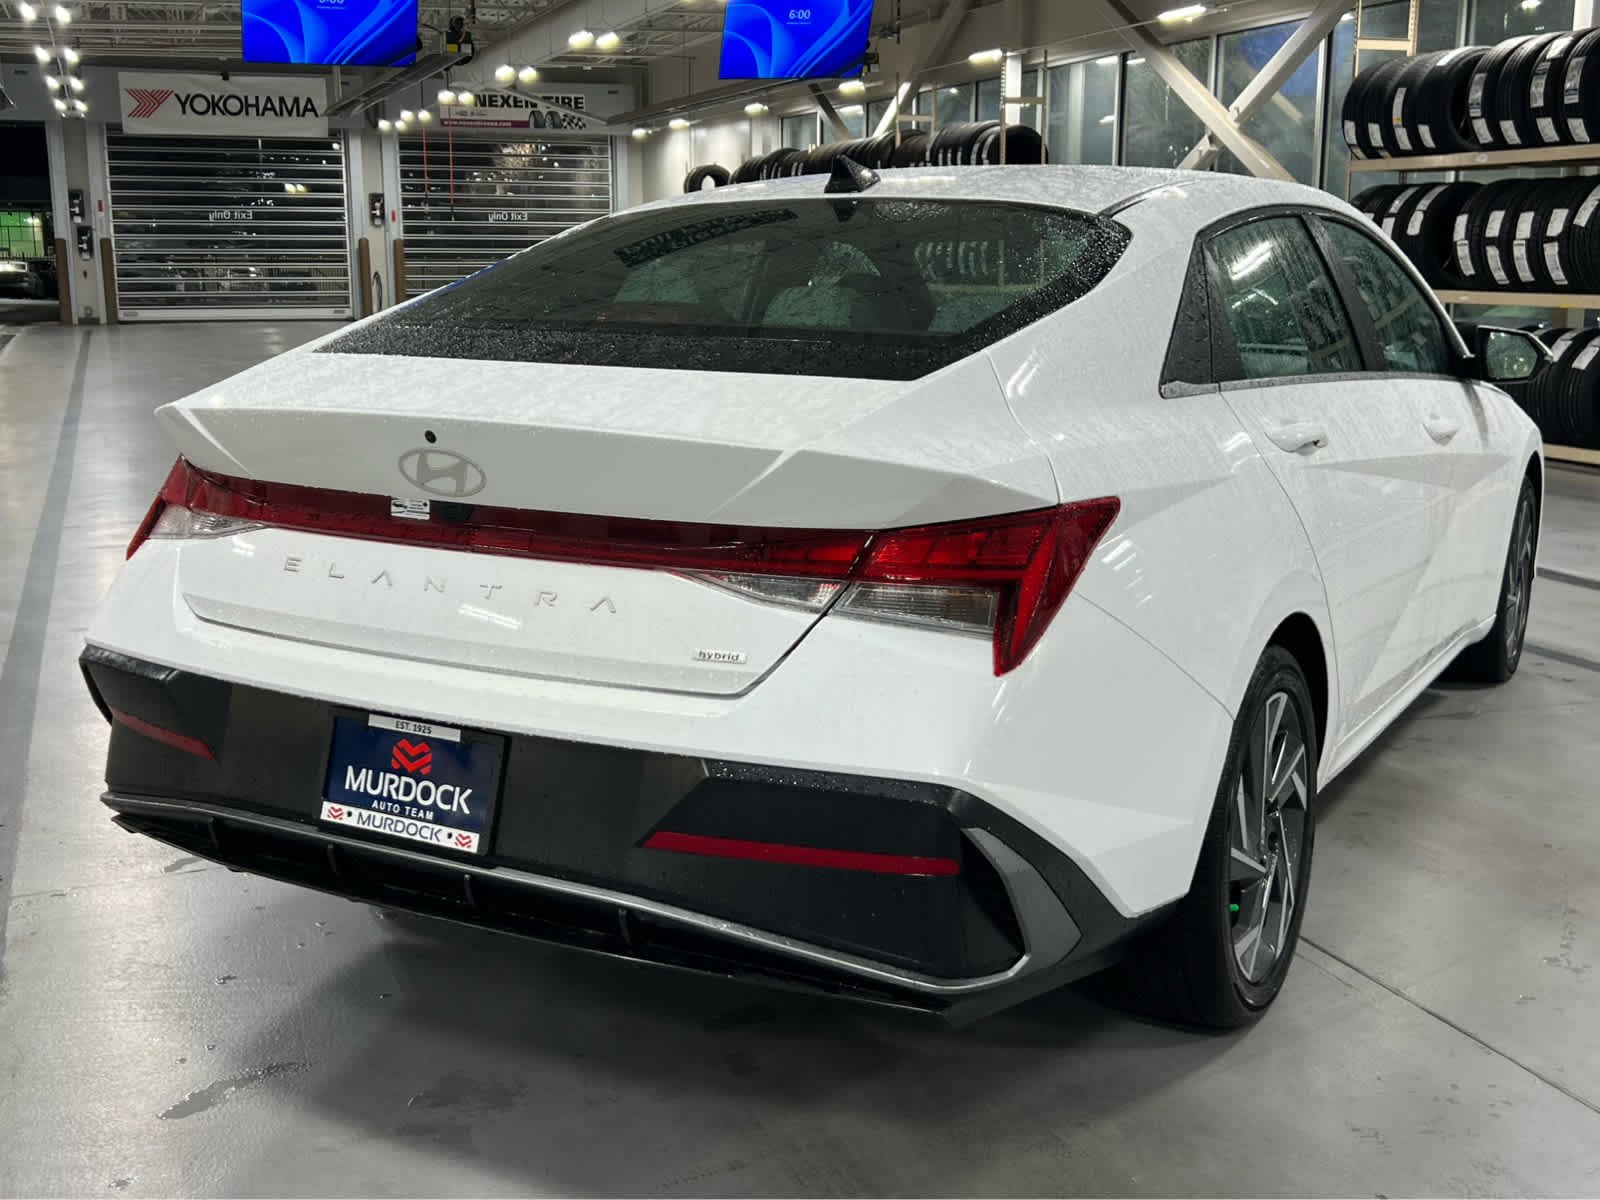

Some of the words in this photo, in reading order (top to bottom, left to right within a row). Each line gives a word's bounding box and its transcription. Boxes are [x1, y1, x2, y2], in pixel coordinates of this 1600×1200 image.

[789, 9, 811, 20] 6:00
[174, 93, 319, 118] YOKOHAMA
[283, 556, 617, 614] ELANTRA
[698, 650, 740, 662] hybrid
[395, 720, 412, 732] EST.
[413, 724, 433, 735] 1925
[344, 765, 473, 815] MURDOCK
[371, 799, 401, 814] AUTO
[404, 806, 435, 821] TEAM
[356, 811, 443, 842] MURDOCK
